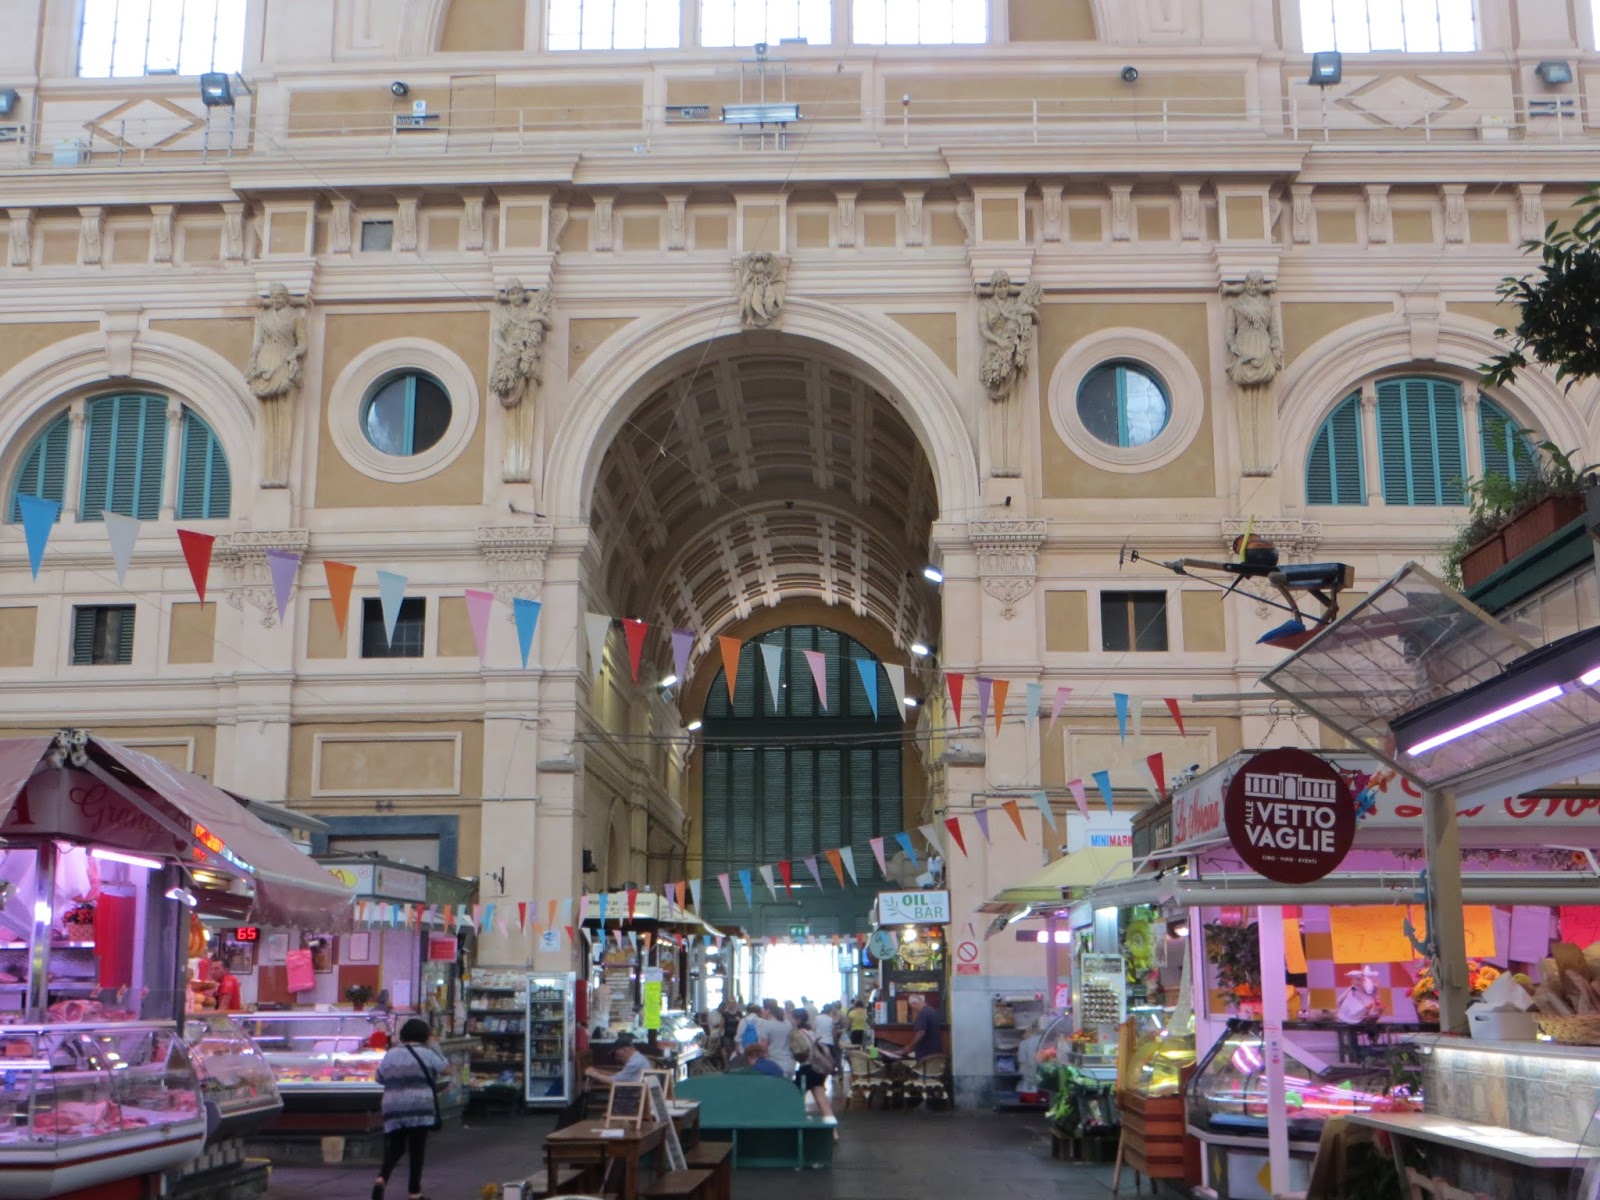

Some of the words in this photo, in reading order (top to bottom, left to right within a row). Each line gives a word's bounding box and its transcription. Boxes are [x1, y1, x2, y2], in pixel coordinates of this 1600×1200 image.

[1245, 801, 1254, 824] ALLE
[1256, 801, 1336, 829] VETTO
[1245, 824, 1335, 853] VAGLIE
[901, 894, 928, 907] OIL
[914, 906, 943, 919] BAR
[237, 928, 257, 940] 65
